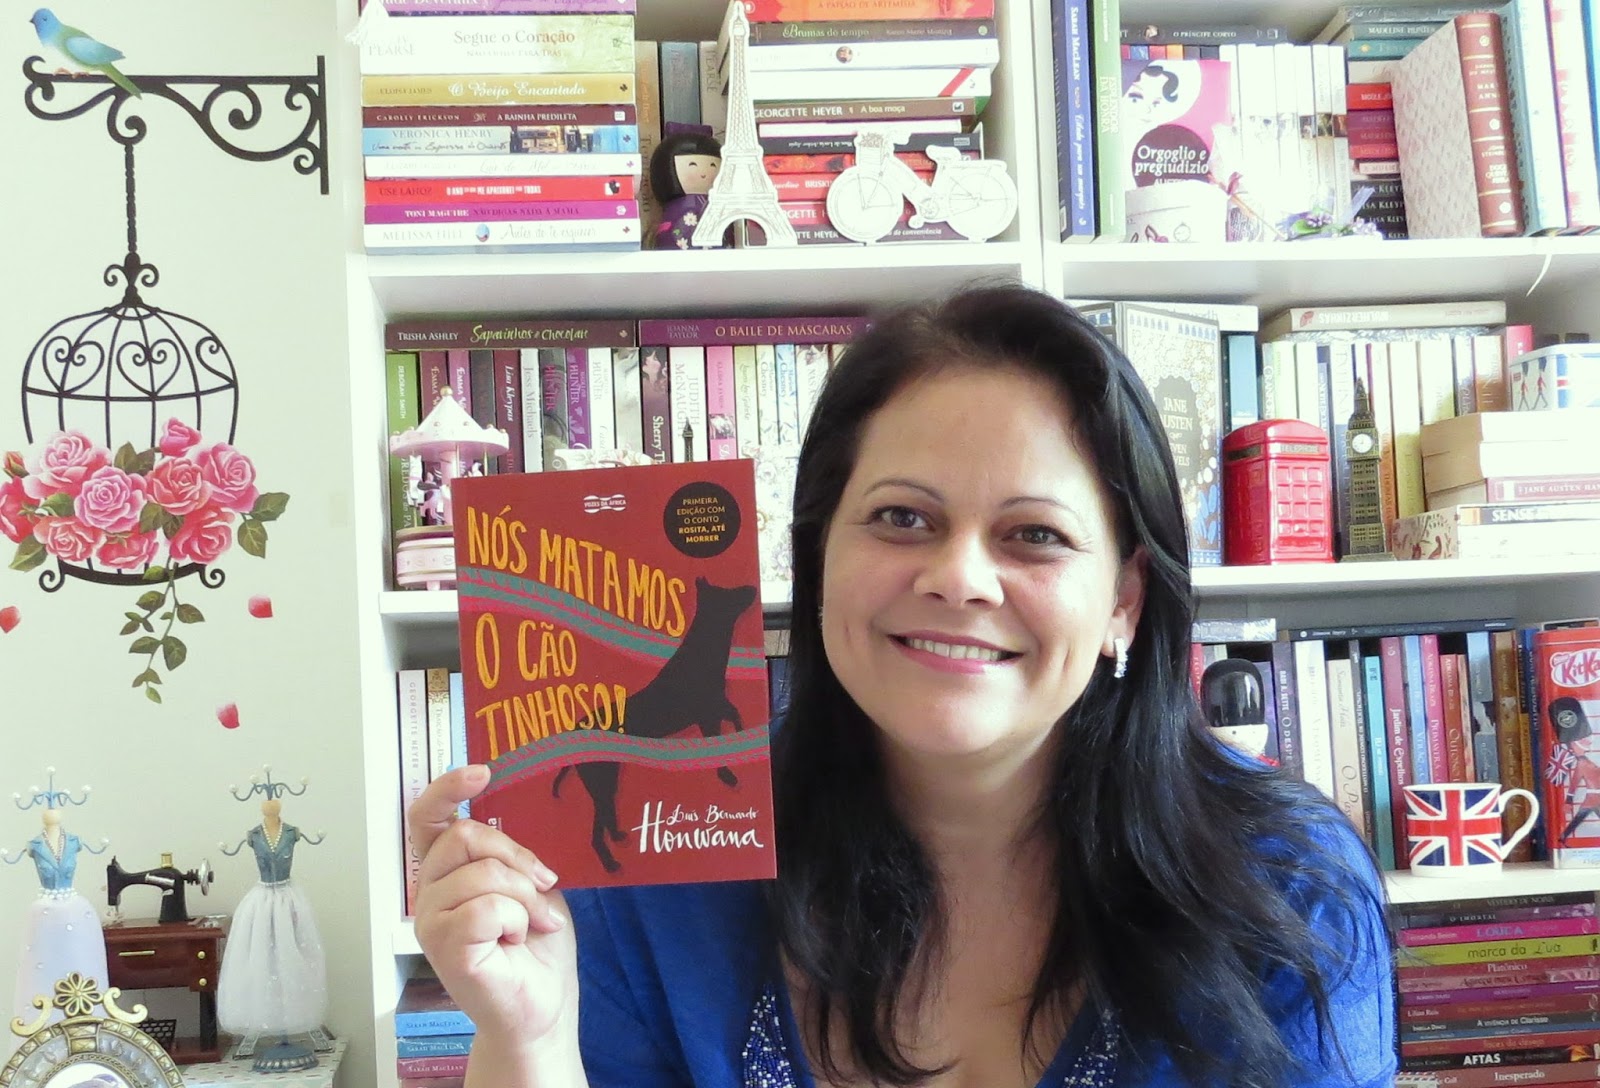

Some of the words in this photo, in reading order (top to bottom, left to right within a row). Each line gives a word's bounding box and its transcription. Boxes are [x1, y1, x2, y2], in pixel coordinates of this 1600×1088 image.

[1070, 6, 1079, 34] SARAH
[454, 31, 497, 46] Segue
[502, 34, 511, 44] o
[515, 31, 576, 45] Coração
[782, 24, 824, 39] Brumas
[841, 27, 870, 39] tempo
[468, 82, 513, 100] Beijo
[514, 82, 587, 97] Encantado
[504, 113, 535, 121] RAINHA
[536, 113, 577, 121] PREDILETA
[753, 107, 808, 118] GEORGETTE
[812, 106, 843, 116] HEYER
[860, 105, 868, 114] A
[869, 105, 882, 113] boa
[884, 105, 906, 115] moça
[454, 128, 493, 138] HENRY
[1137, 145, 1194, 162] Orgoglio
[1199, 149, 1207, 160] e
[1134, 160, 1209, 177] pregiudizio
[405, 209, 426, 218] TONI
[427, 209, 469, 217] MAGUIRE
[398, 331, 427, 341] TRISHA
[428, 331, 459, 341] ASHLEY
[715, 326, 725, 337] O
[730, 326, 763, 337] BAILE
[767, 325, 784, 336] DE
[456, 366, 465, 395] EMMA
[504, 365, 514, 384] Lisa
[523, 367, 535, 390] Jess
[592, 361, 602, 401] HUNTER
[760, 361, 768, 397] Chesney
[780, 362, 788, 397] Chesney
[569, 364, 579, 405] HUNTER
[504, 386, 515, 421] Kleypas
[687, 376, 700, 425] JUDITH
[1163, 396, 1187, 413] JANE
[525, 391, 538, 438] Michaels
[653, 415, 664, 449] Sherry
[1174, 455, 1190, 467] VELS
[1524, 485, 1545, 494] JANE
[1548, 484, 1580, 492] AUSTEN
[682, 497, 718, 506] PRIMEIRA
[676, 506, 706, 516] EDIÇÃO
[707, 505, 725, 514] COM
[683, 517, 691, 525] O
[691, 515, 720, 524] CONTO
[678, 525, 710, 535] ROSITA,
[711, 523, 726, 533] ATÉ
[686, 534, 720, 544] MORRER
[467, 504, 528, 574] NÓS
[539, 527, 687, 638] MATAMOS
[475, 612, 500, 689] O
[517, 619, 577, 682] CÃO
[1561, 651, 1600, 685] KitKa
[409, 681, 419, 735] GEORGETTE
[475, 681, 628, 761] TINHOSO!
[1391, 708, 1402, 735] Jardim
[1284, 730, 1293, 761] DESPE
[1394, 736, 1403, 747] de
[1430, 719, 1441, 769] PRIMAVERA
[411, 740, 420, 769] HEYER
[1449, 728, 1460, 774] OUTONO
[1341, 765, 1358, 780] O
[704, 803, 760, 824] Bernardo
[630, 800, 765, 854] Honwana
[1467, 947, 1507, 959] marca
[1511, 943, 1526, 955] da
[1533, 942, 1562, 954] Lua
[1476, 1019, 1483, 1027] A
[1463, 1053, 1501, 1066] AFTAS
[1494, 1069, 1545, 1082] Inesperado
